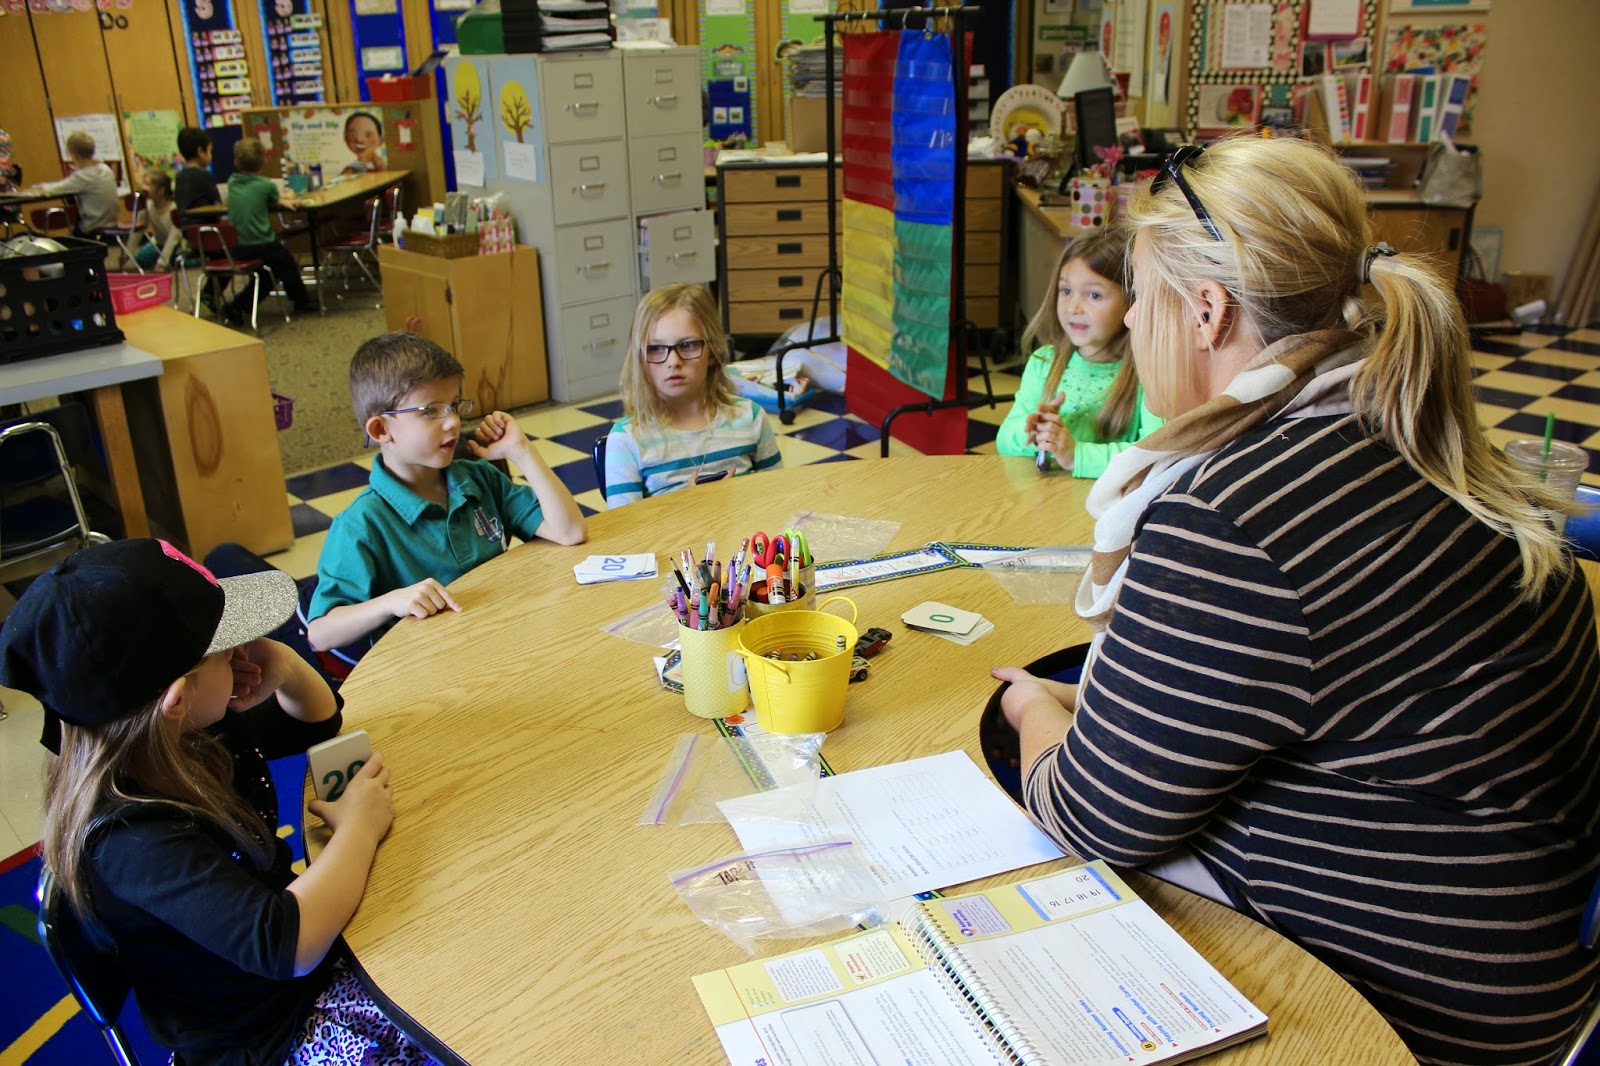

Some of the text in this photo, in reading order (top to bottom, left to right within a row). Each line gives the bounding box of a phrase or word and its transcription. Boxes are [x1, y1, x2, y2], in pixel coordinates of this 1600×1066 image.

[99, 12, 129, 30] Do
[602, 556, 626, 571] 20
[1075, 873, 1089, 883] 20
[1076, 891, 1087, 900] 18
[1089, 888, 1101, 897] 19
[1049, 898, 1060, 907] 16
[1063, 895, 1074, 904] 17
[1116, 984, 1175, 1042] Playing with Number Cards
[1177, 991, 1216, 1027] Tracing Numbers
[1089, 1013, 1108, 1031] Number
